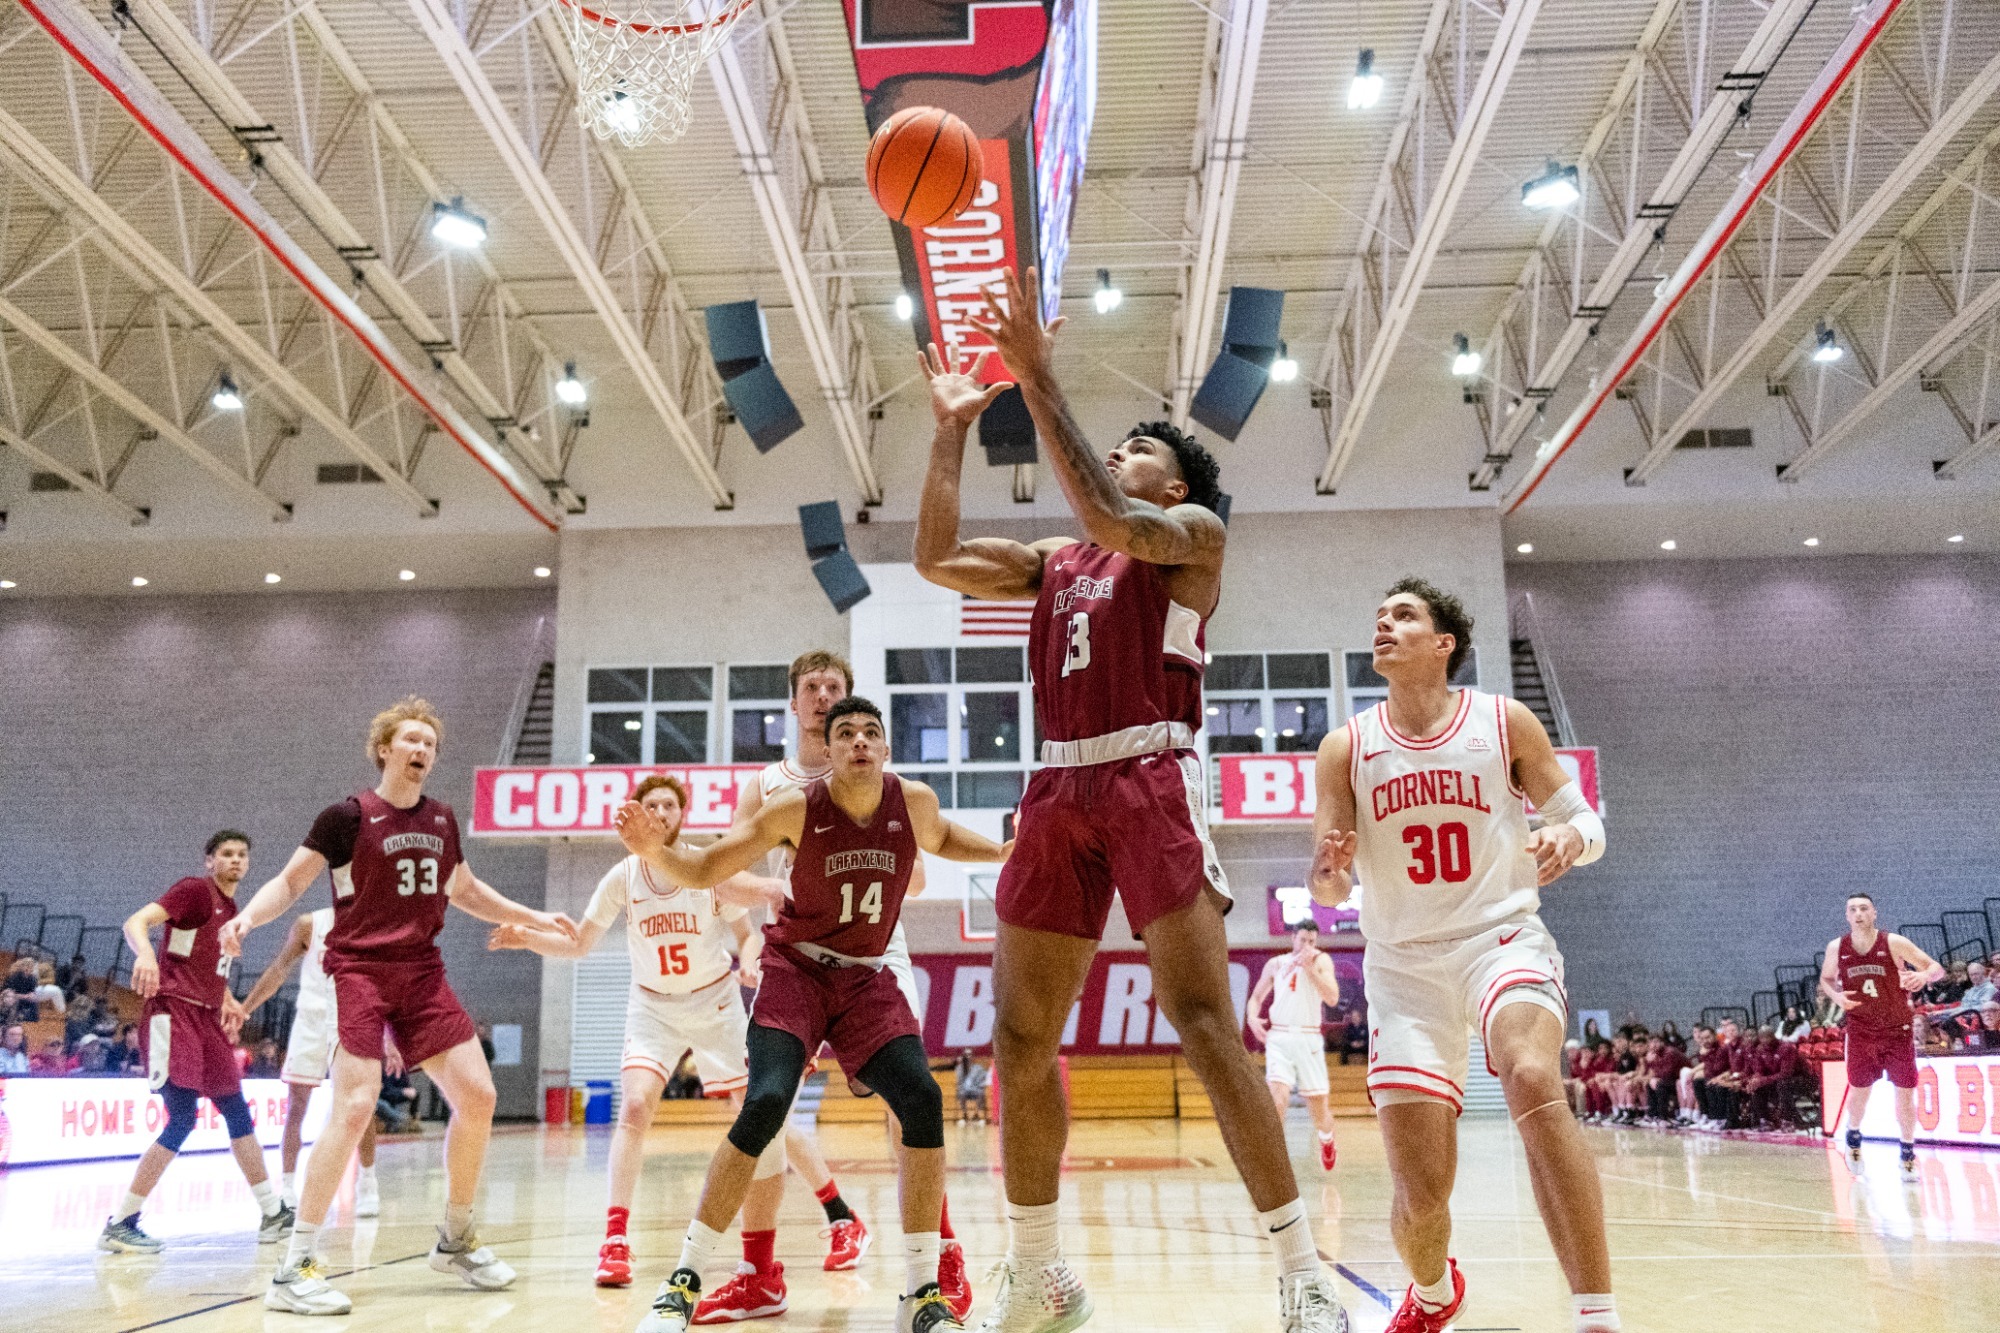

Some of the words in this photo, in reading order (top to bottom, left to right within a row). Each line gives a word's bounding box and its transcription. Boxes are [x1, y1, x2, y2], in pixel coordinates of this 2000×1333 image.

[493, 770, 758, 827] CORE
[1372, 769, 1491, 822] CORNELL
[825, 849, 896, 877] LAFAYETTE
[1402, 822, 1471, 884] 30
[396, 858, 438, 896] 33
[839, 881, 883, 924] 14
[639, 912, 701, 938] CORNELL
[657, 943, 690, 976] 15
[1862, 979, 1879, 998] 4
[61, 1099, 135, 1138] HOME
